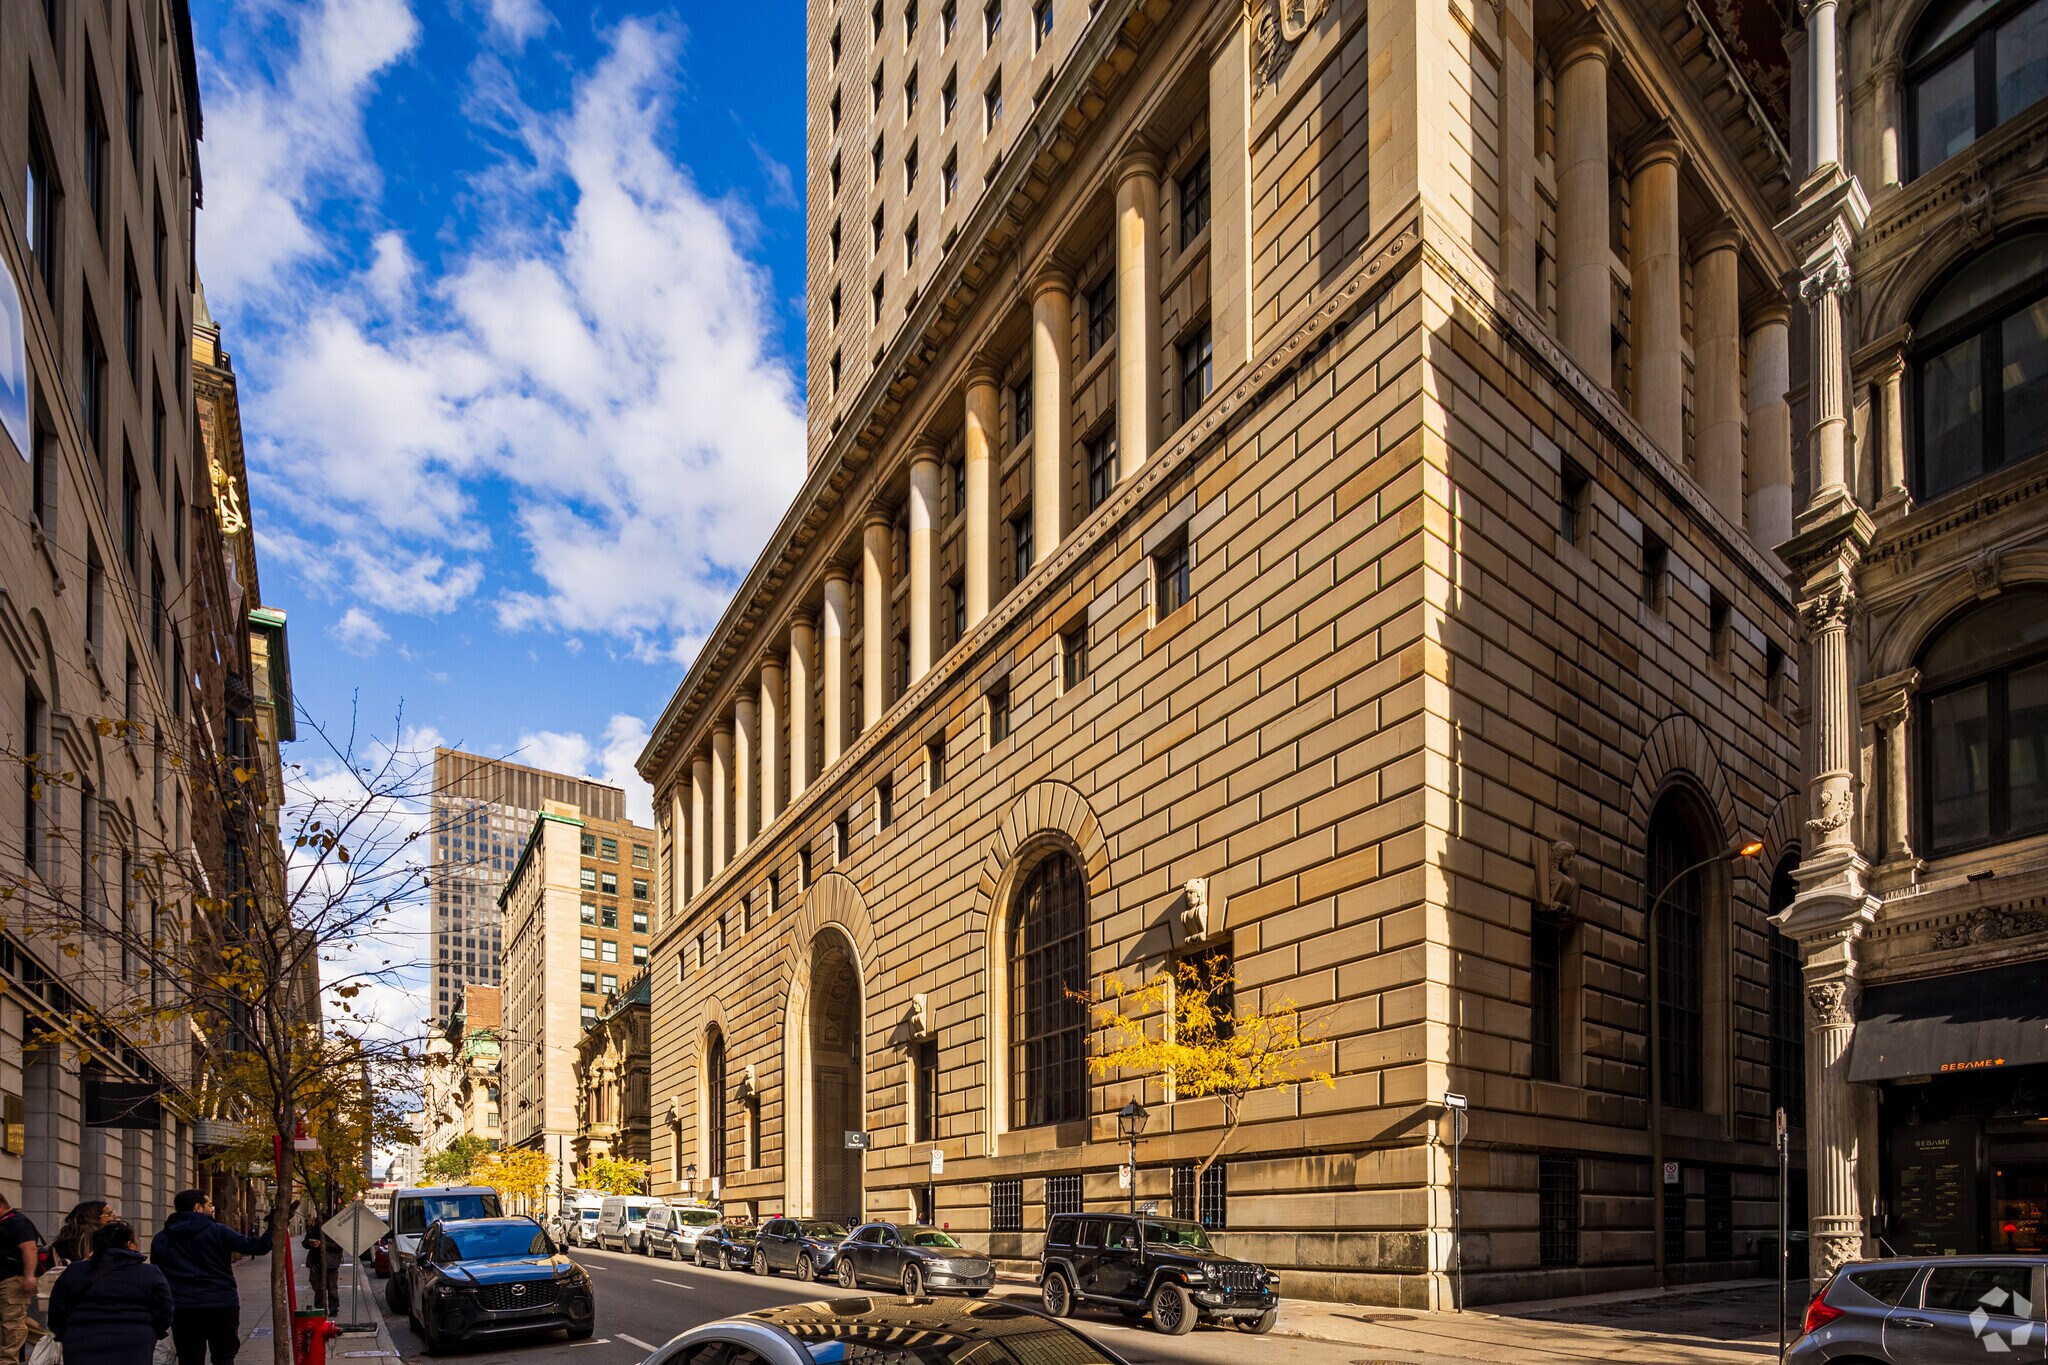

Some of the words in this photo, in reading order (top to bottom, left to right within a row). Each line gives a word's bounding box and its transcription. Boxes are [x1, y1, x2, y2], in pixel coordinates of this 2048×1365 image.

[1941, 1059, 1992, 1071] SESAME
[852, 1134, 860, 1143] C
[1915, 1139, 1950, 1147] SESAME
